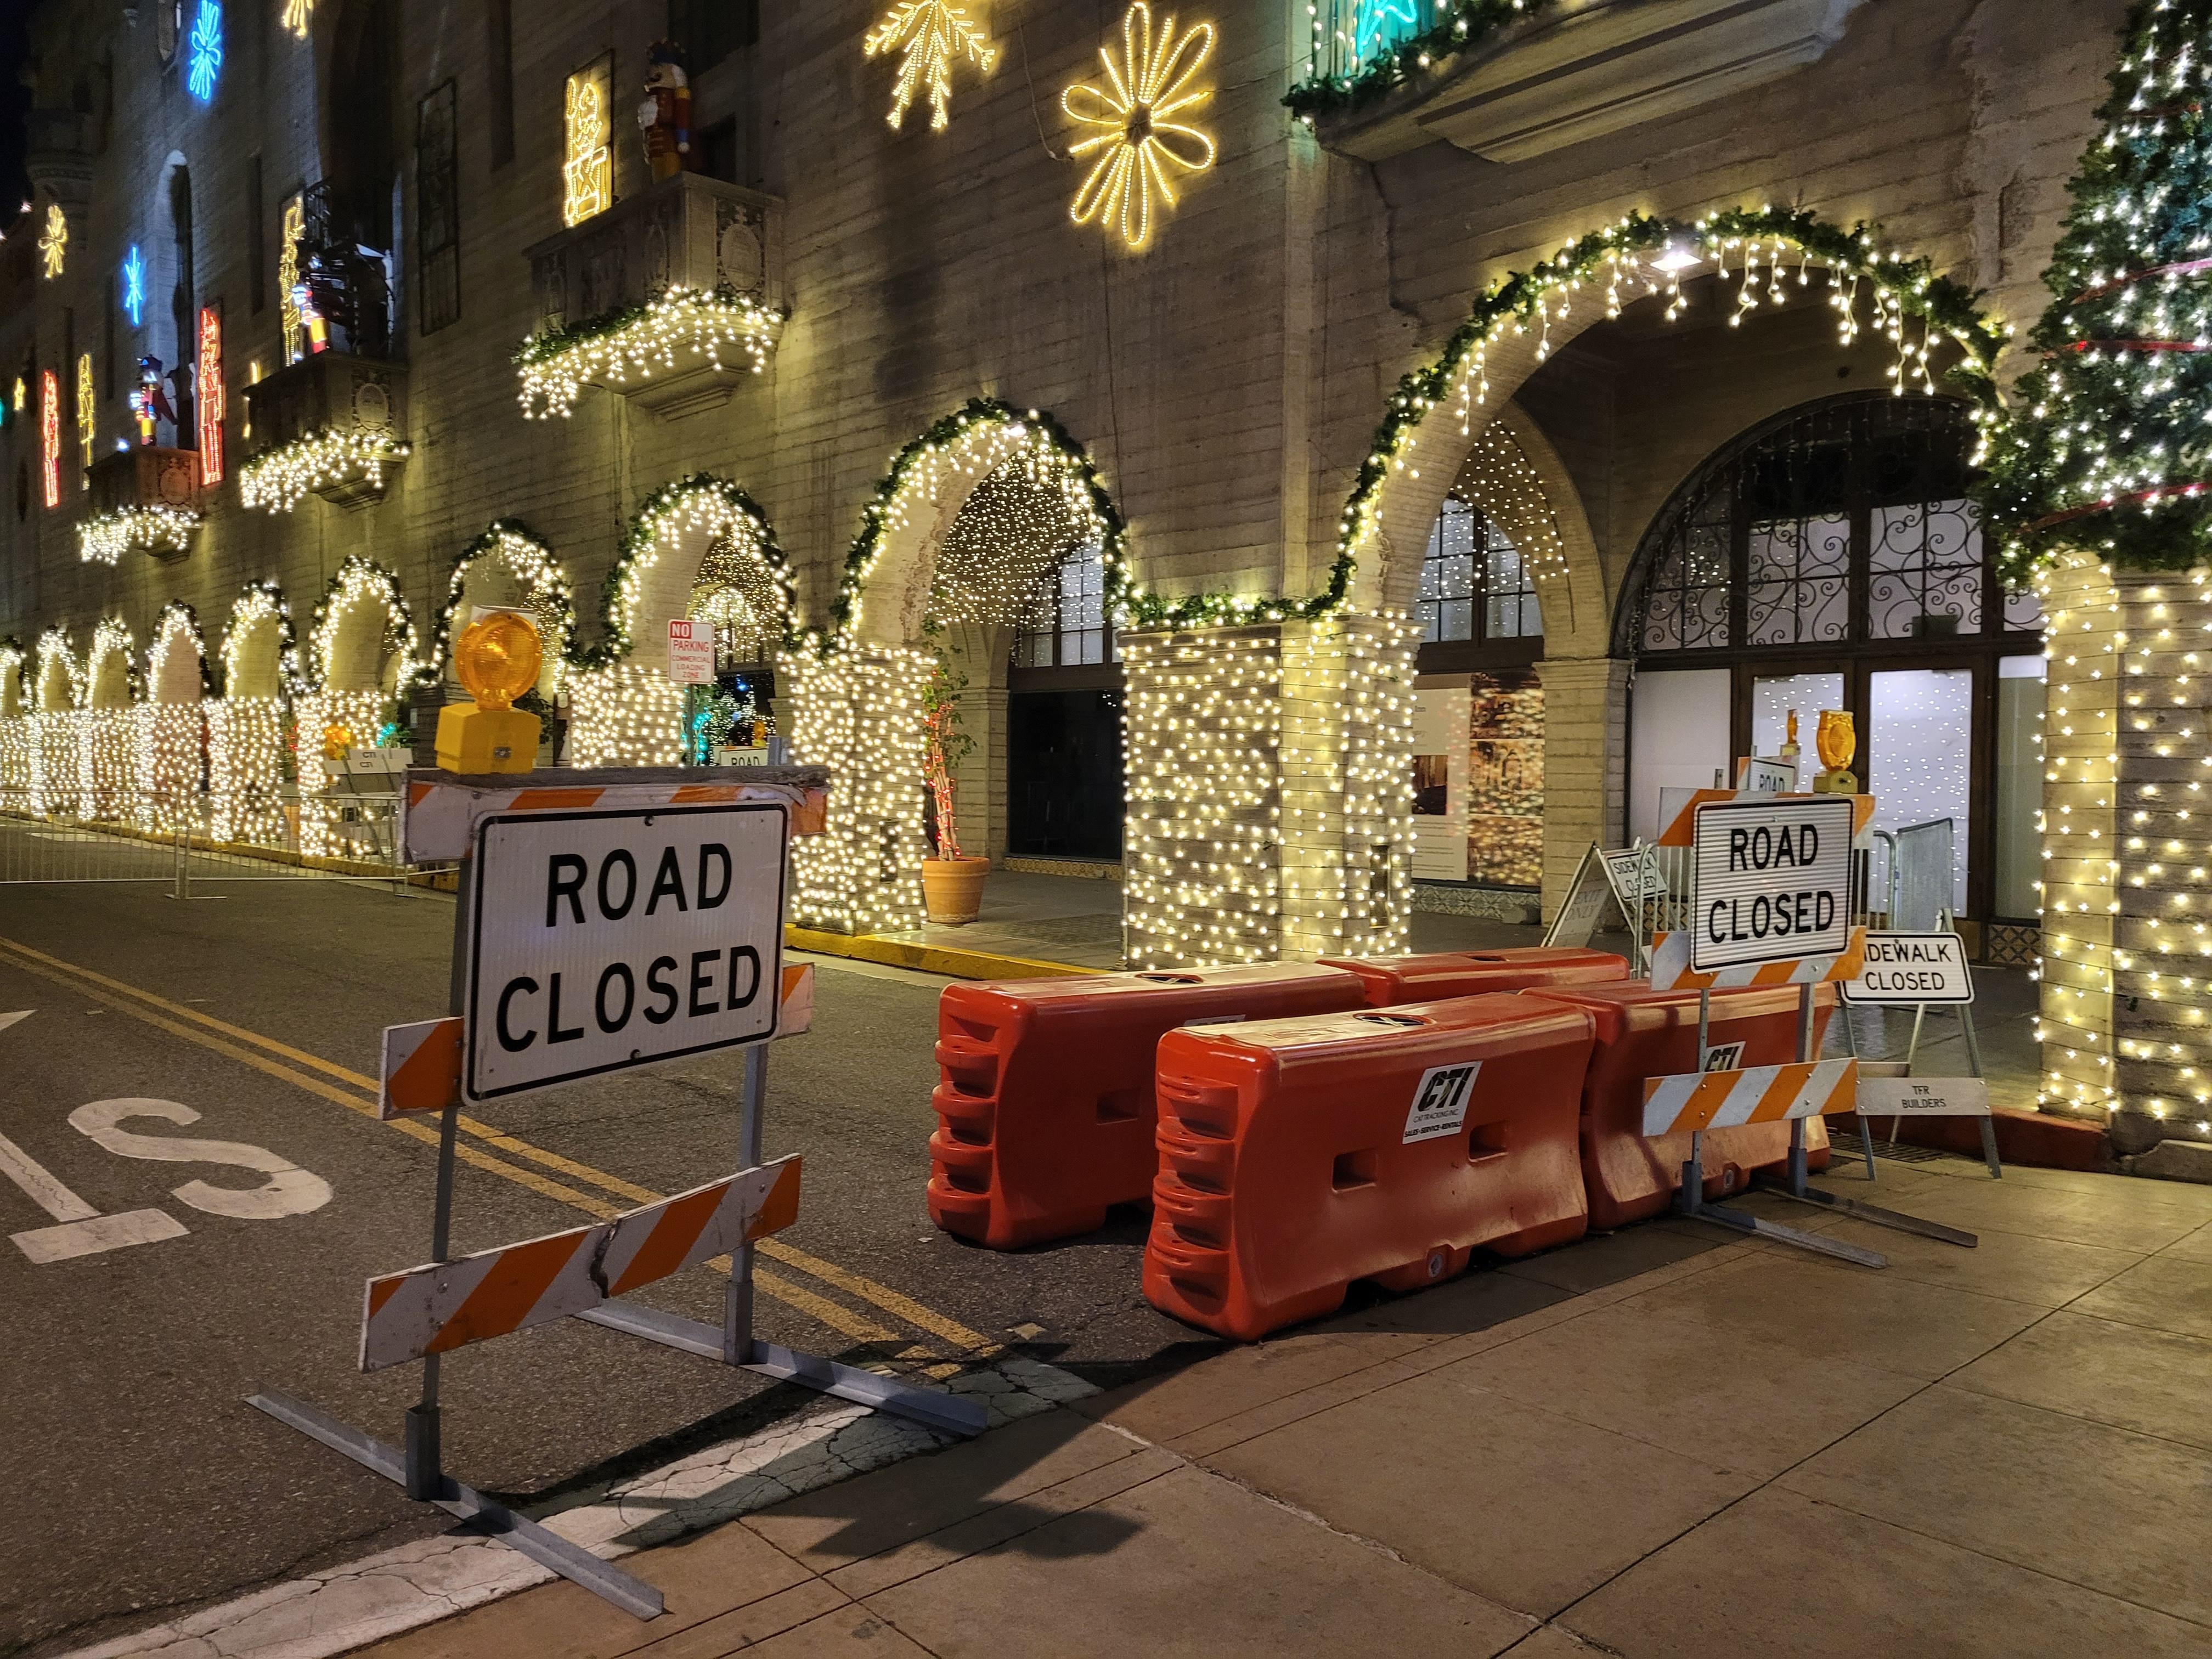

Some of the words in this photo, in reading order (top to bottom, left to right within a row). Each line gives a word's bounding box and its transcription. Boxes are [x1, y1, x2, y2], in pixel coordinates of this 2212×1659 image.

[672, 623, 690, 637] NO
[673, 640, 709, 652] PARKING
[672, 654, 711, 663] COMMERCIAL
[731, 756, 760, 766] ROAD
[1759, 774, 1785, 792] ROAD
[1730, 824, 1818, 872] ROAD
[1613, 857, 1655, 874] SIDEWK
[546, 843, 732, 928] ROAD
[1709, 890, 1835, 944] CLOSED
[1864, 944, 1952, 962] IDEWALK
[1865, 972, 1945, 990] CLOSED
[496, 945, 761, 1052] CLOSED
[1417, 1066, 1475, 1111] CTI
[1912, 1086, 1931, 1095] TFR
[1901, 1098, 1947, 1109] BUILDERS
